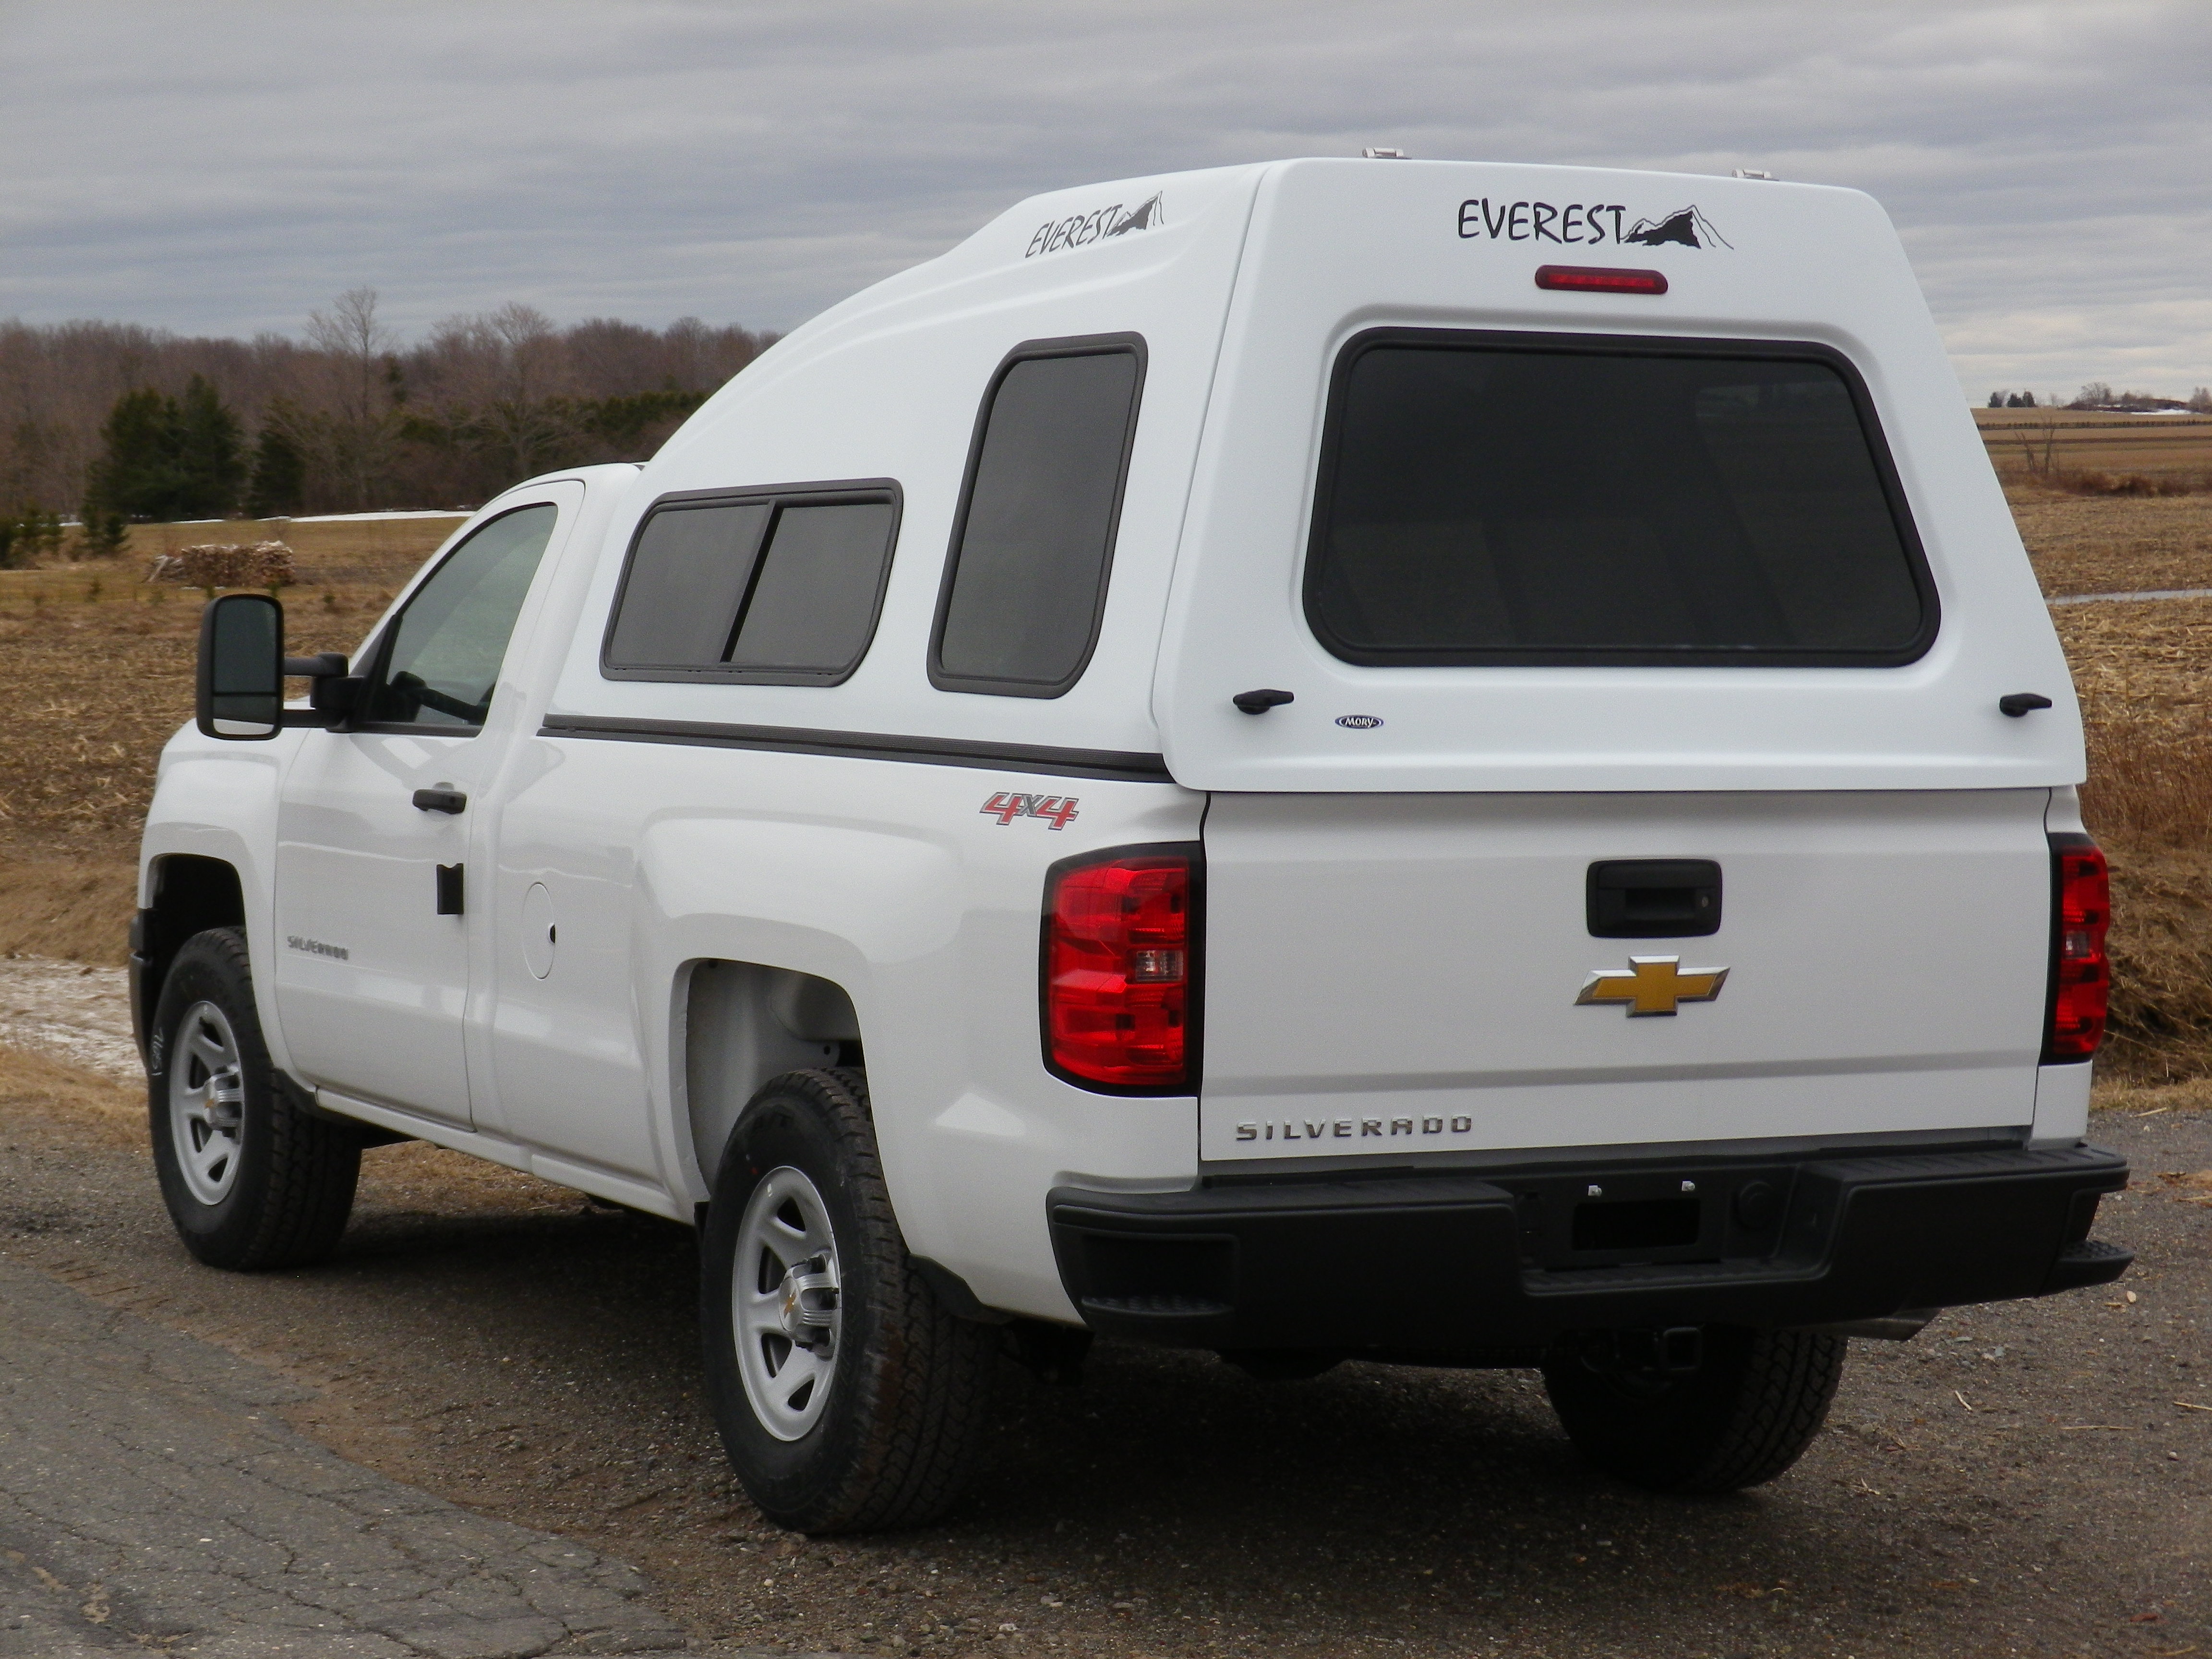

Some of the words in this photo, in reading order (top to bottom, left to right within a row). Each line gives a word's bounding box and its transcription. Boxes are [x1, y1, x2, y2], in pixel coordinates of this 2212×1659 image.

[1025, 204, 1123, 258] EVEREST
[1458, 198, 1626, 245] EVEREST
[1236, 1113, 1472, 1141] SILVERADO
